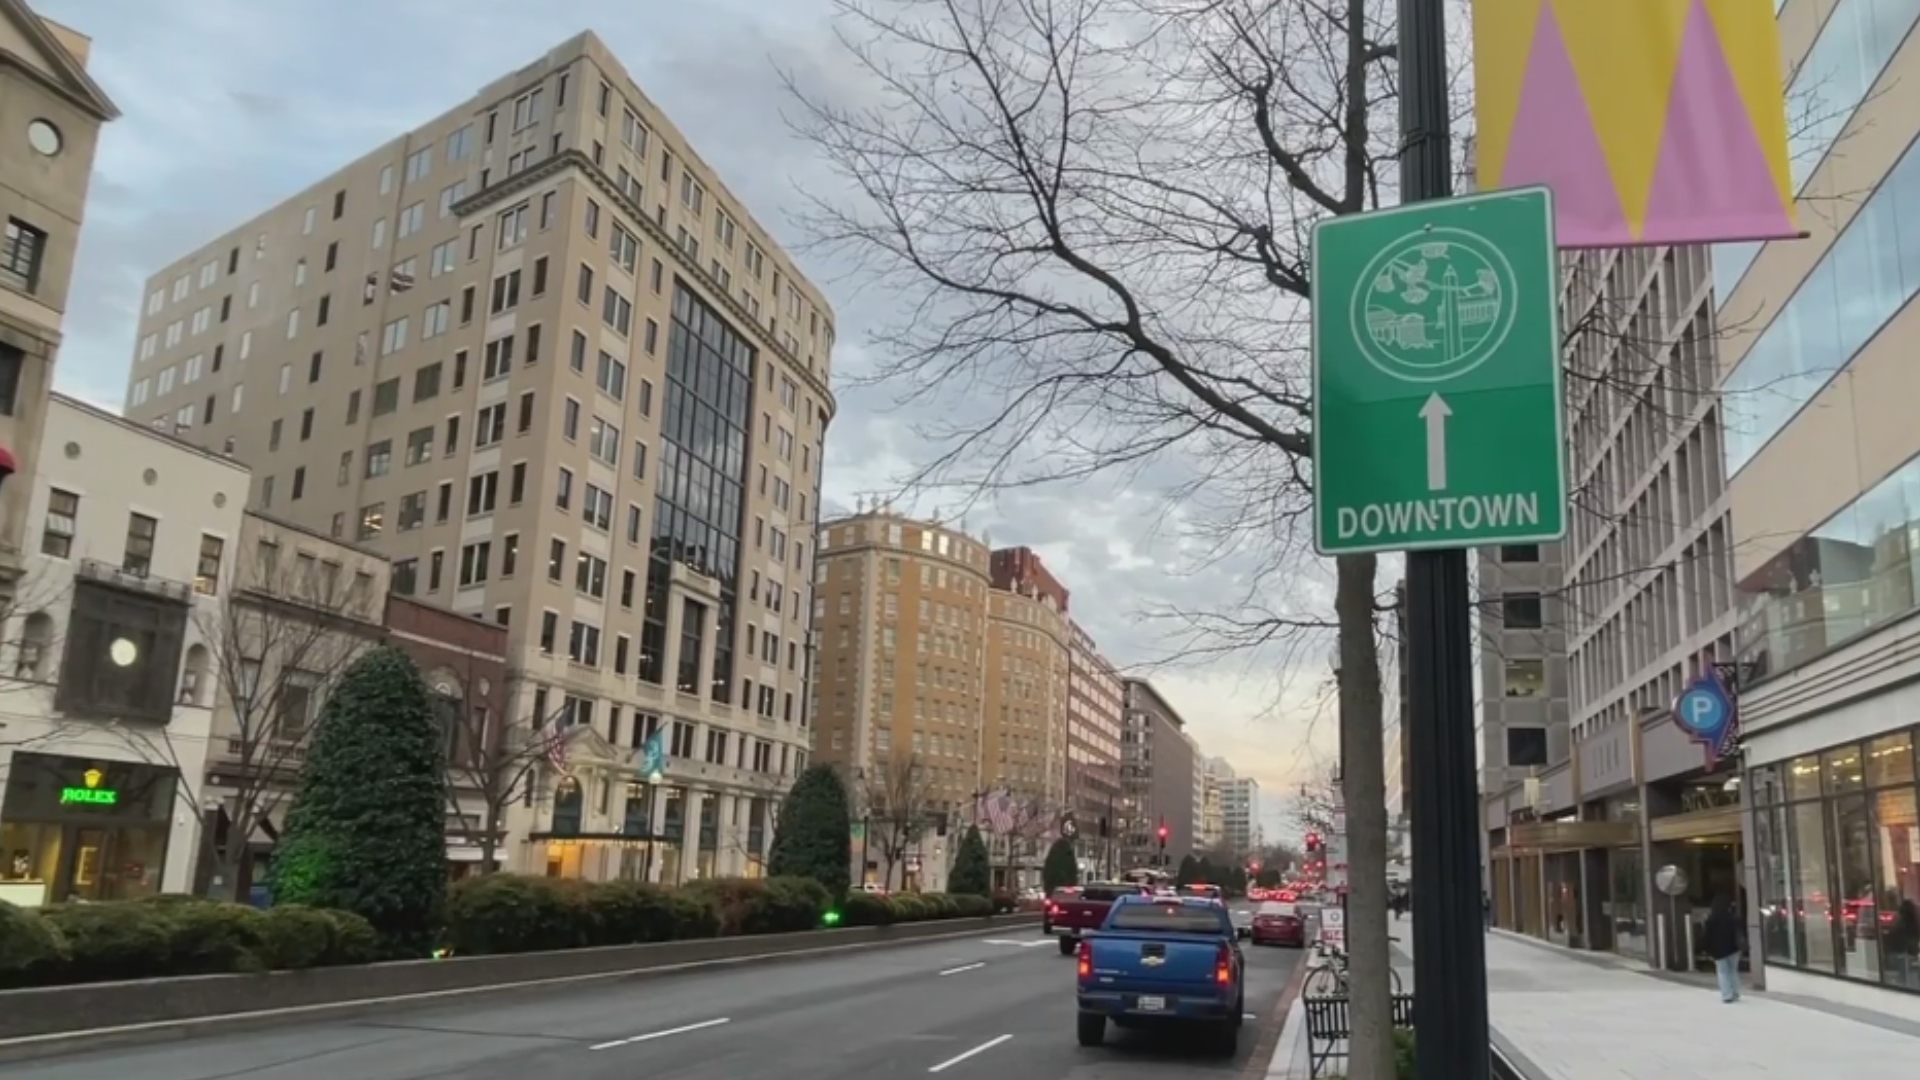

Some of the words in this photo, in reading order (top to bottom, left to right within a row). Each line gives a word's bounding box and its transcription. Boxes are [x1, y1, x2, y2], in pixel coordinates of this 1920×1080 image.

[1337, 492, 1539, 539] DOWNTOWN
[1692, 696, 1713, 723] P
[60, 787, 117, 804] ROLEX
